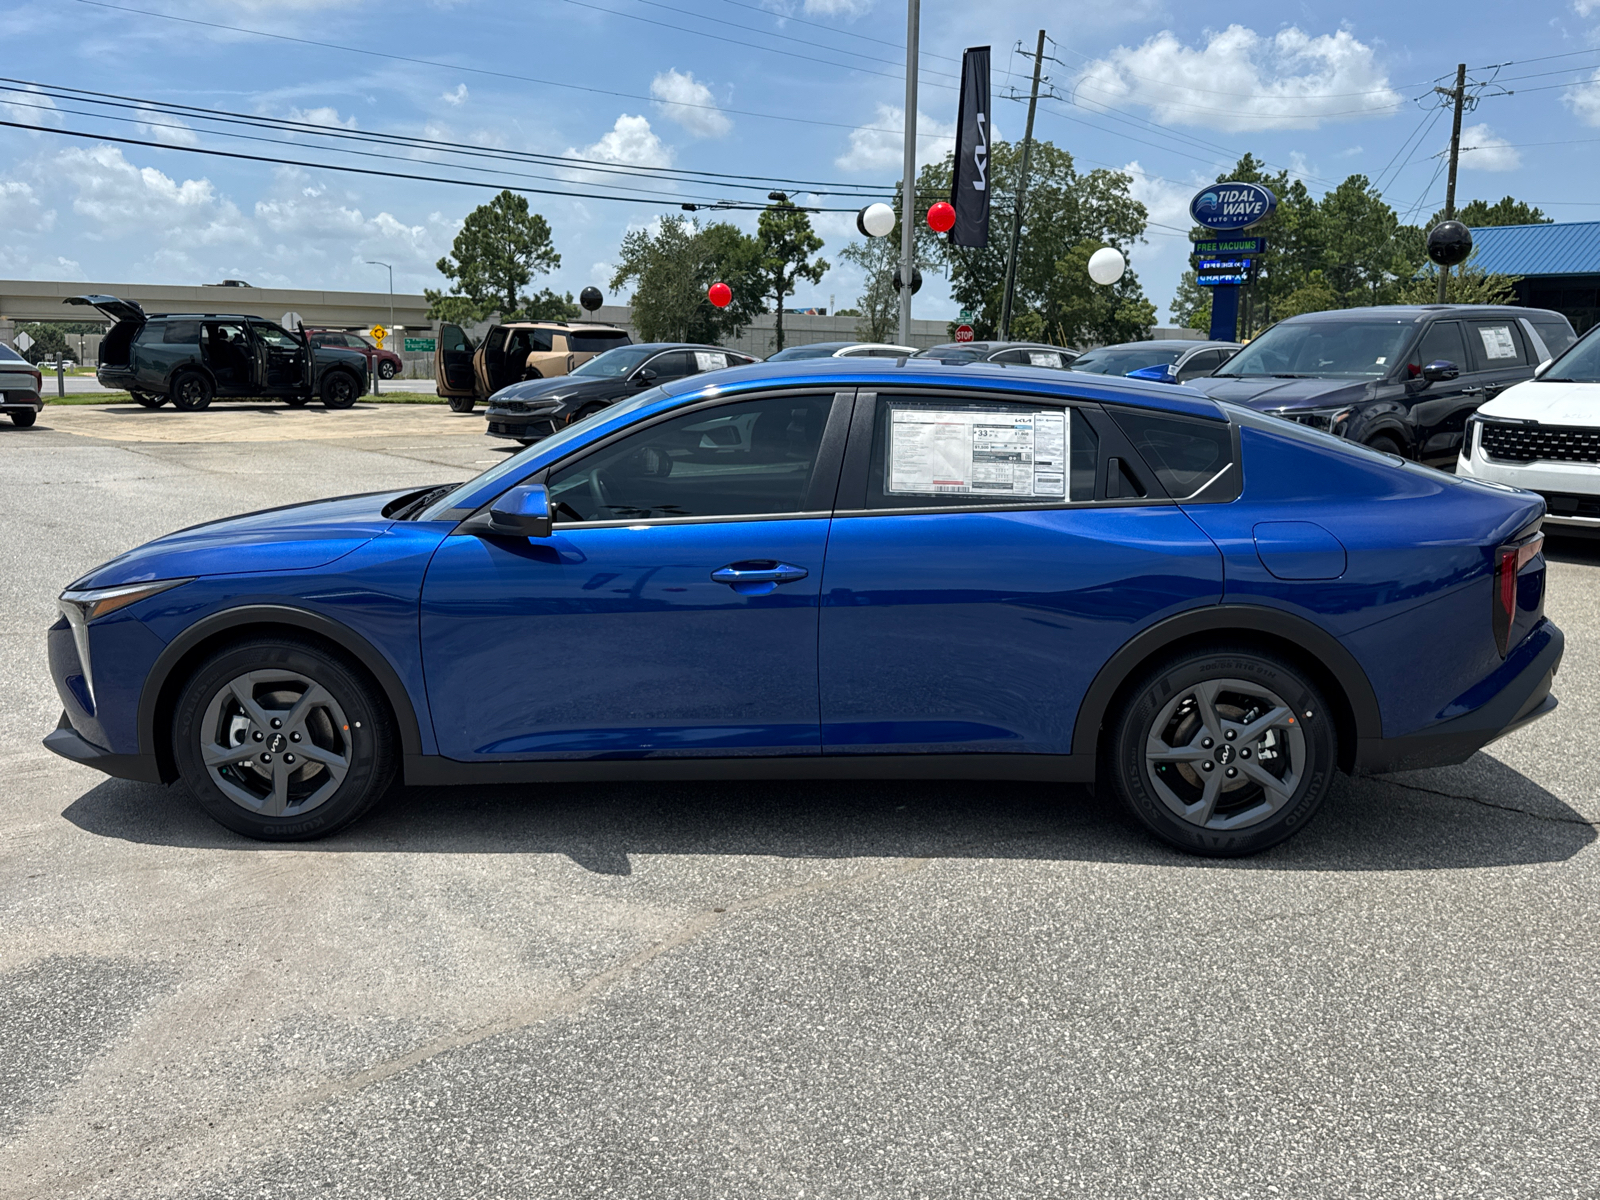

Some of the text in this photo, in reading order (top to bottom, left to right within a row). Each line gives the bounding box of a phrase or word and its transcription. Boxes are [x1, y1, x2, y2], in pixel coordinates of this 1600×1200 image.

[972, 113, 987, 191] KIA
[1218, 190, 1255, 203] TIDAL
[1223, 202, 1262, 215] WAVE
[1197, 240, 1256, 252] FREE VACUUMS
[956, 331, 973, 340] STOP
[978, 429, 988, 437] 33
[1199, 662, 1233, 673] 205/55
[1235, 662, 1255, 671] R16
[181, 683, 208, 737] SOLUS
[1129, 765, 1161, 819] SOLUS
[1285, 771, 1325, 826] KUMHO
[263, 816, 326, 835] KUMHO
